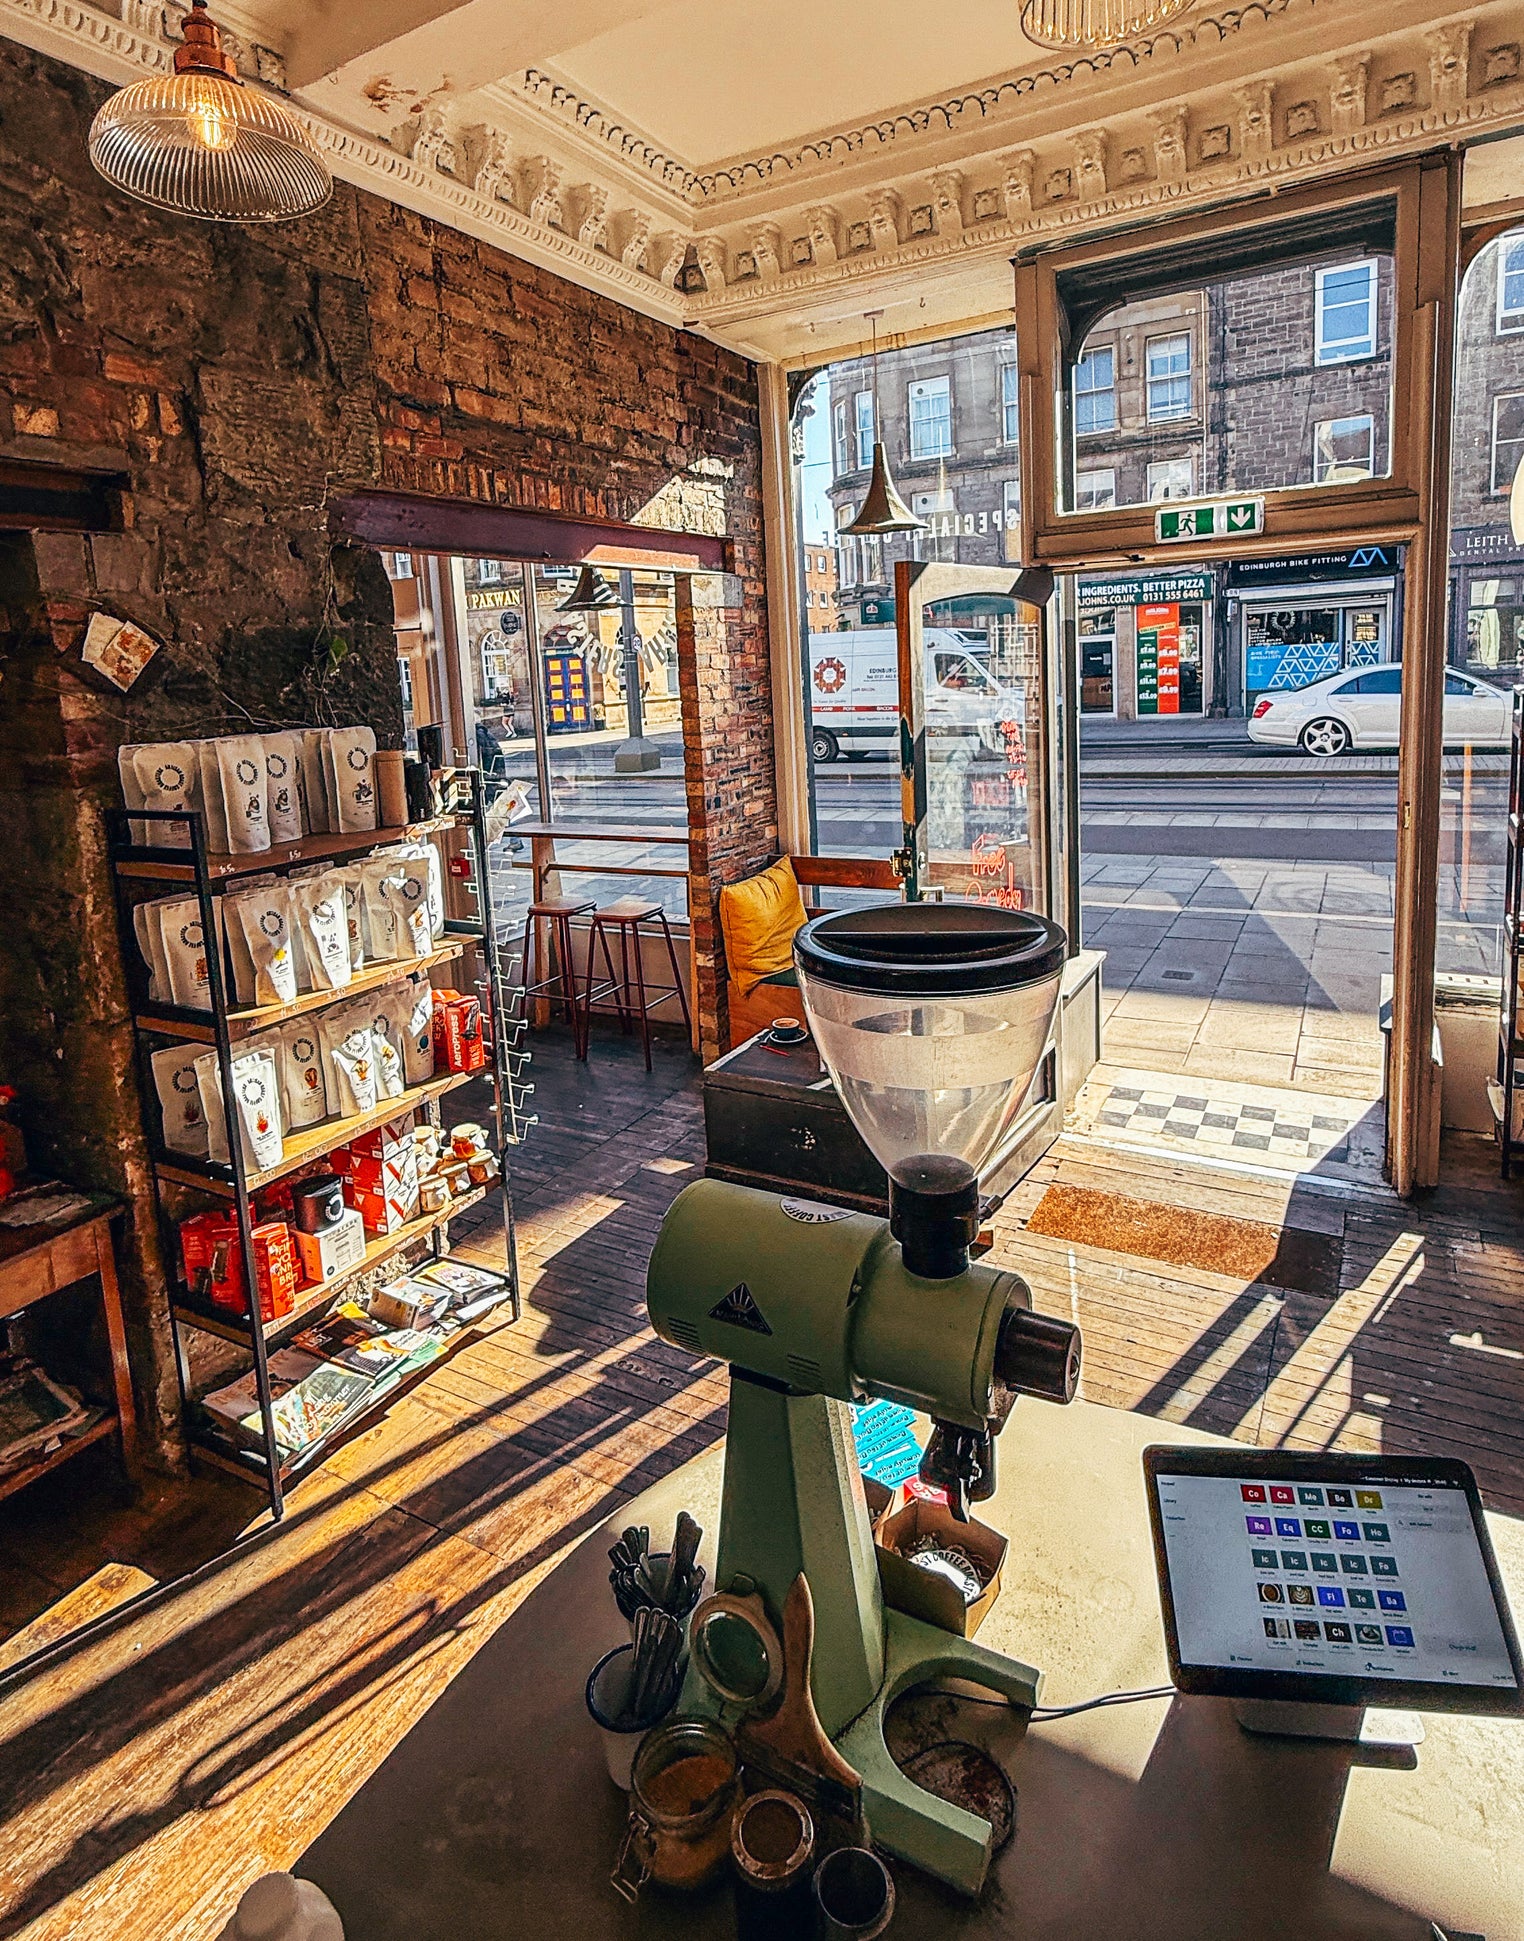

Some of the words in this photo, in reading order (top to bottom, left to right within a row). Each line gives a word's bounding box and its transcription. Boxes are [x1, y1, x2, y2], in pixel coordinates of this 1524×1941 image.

[1467, 534, 1509, 548] LEITH
[1459, 547, 1501, 557] DENTAL
[1239, 561, 1287, 572] EDINBURGH
[1289, 559, 1309, 567] BIKE
[1312, 555, 1347, 565] FITTING
[1081, 583, 1142, 597] INGREDIENTS.
[1143, 580, 1177, 593] BETTER
[1178, 578, 1205, 590] PIZZA
[472, 589, 520, 609] PAKWAN
[1078, 594, 1135, 606] JOHNS.CO.UK
[1142, 591, 1164, 602] 0131
[1165, 590, 1181, 600] 555
[1183, 589, 1204, 599] 6461
[1248, 1490, 1259, 1498] Co
[1277, 1492, 1287, 1500] Ca
[1283, 1524, 1294, 1533] Eq
[1311, 1525, 1323, 1533] CC
[1342, 1527, 1351, 1535] Fo
[933, 1552, 965, 1566] COFFEE
[1262, 1555, 1270, 1563] Ic
[1291, 1557, 1299, 1565] Ic
[1320, 1559, 1328, 1567] Ic
[1350, 1560, 1358, 1568] Ic
[1332, 1629, 1344, 1637] Ch
